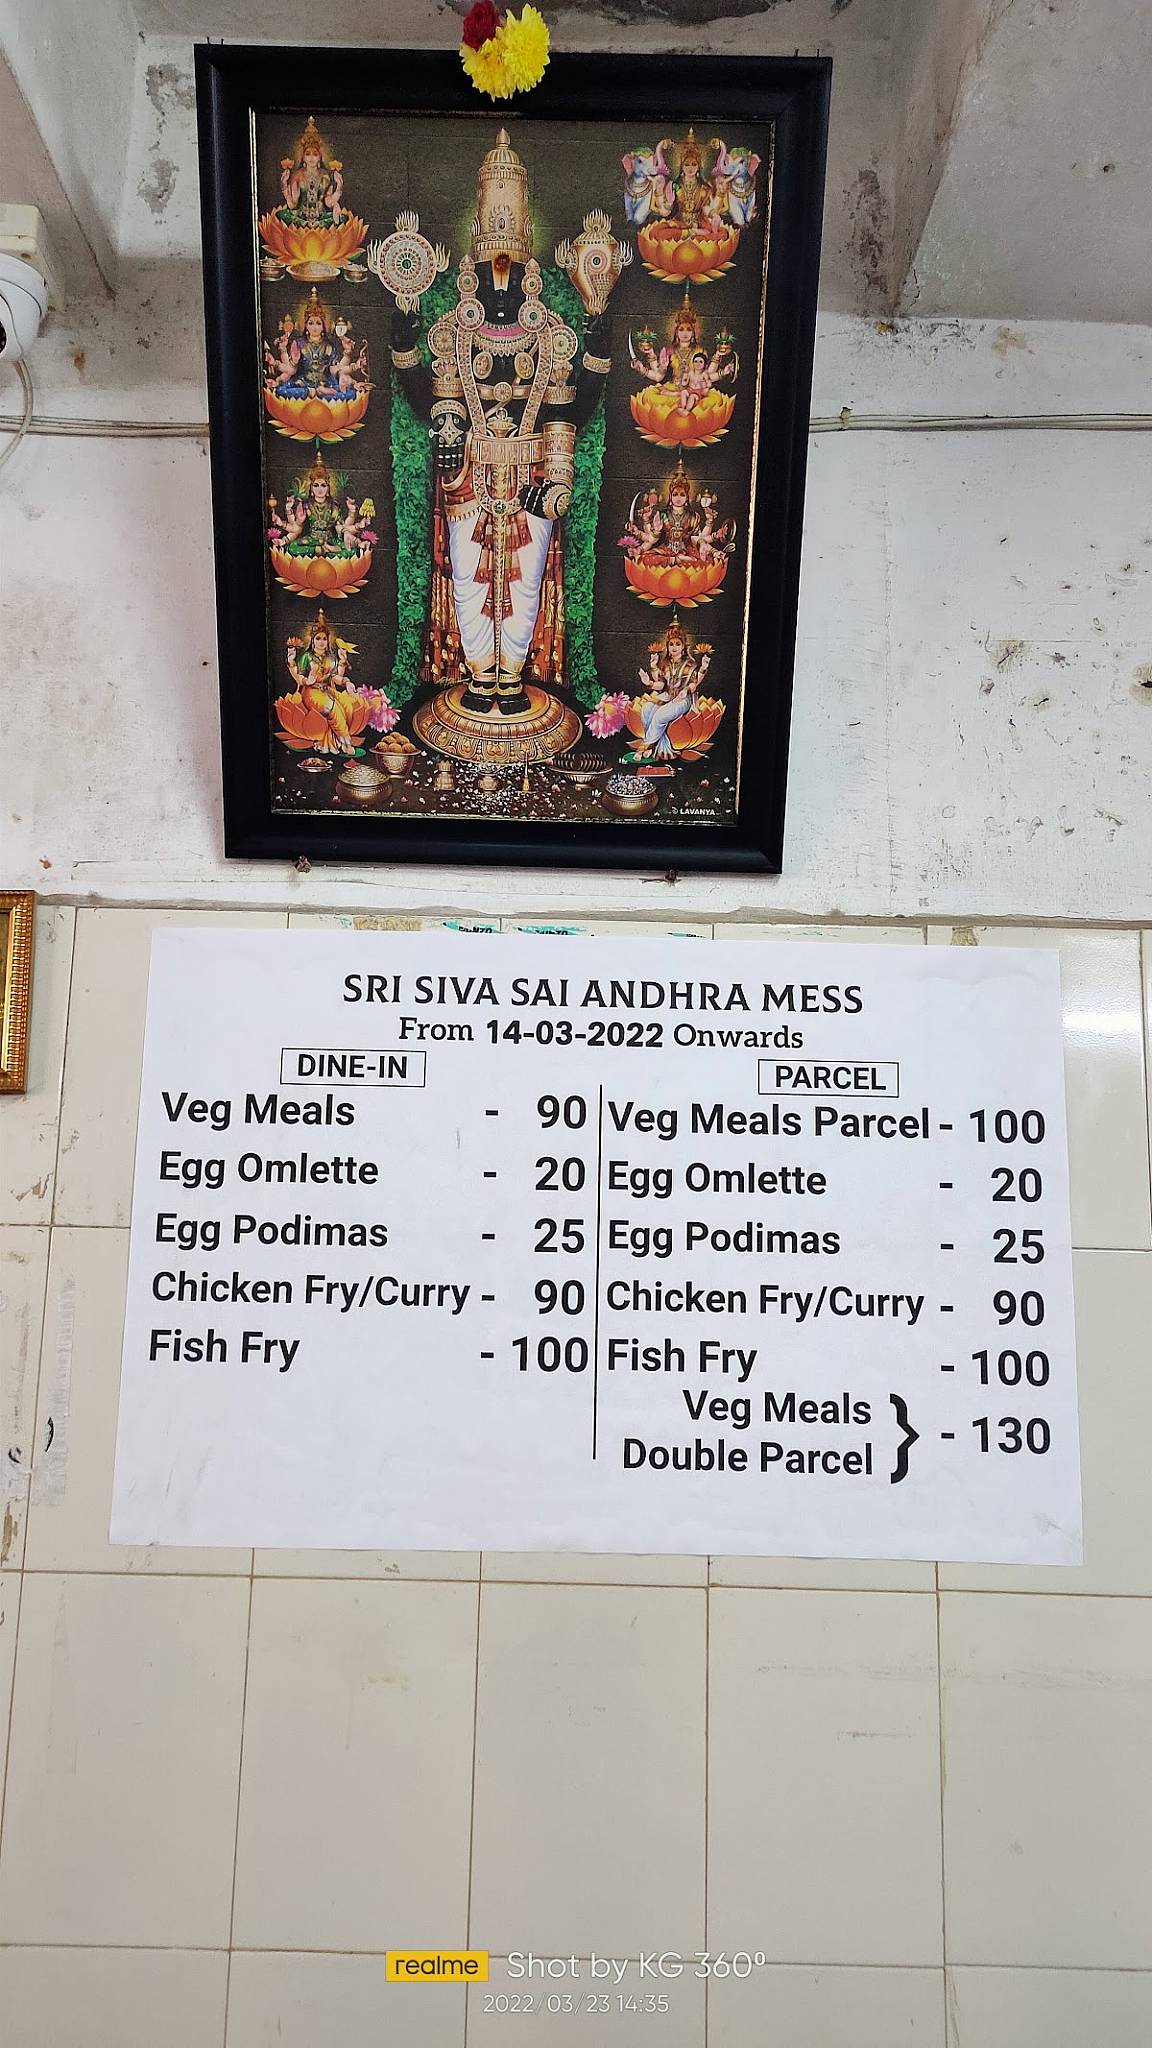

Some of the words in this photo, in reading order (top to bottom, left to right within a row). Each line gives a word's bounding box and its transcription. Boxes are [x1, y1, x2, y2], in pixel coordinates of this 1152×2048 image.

[680, 808, 716, 816] LAVANYA
[343, 974, 402, 1003] SRI
[414, 975, 500, 1006] SIVA
[511, 977, 569, 1007] SAI
[579, 979, 751, 1011] ANDHRA
[761, 983, 863, 1014] MESS
[398, 1016, 475, 1042] From
[486, 1019, 664, 1048] 14-03-2022
[673, 1023, 804, 1049] Onwards
[297, 1053, 408, 1079] DINE-IN
[775, 1065, 887, 1091] PARCEL
[161, 1091, 232, 1132] Veg
[244, 1093, 355, 1126] Meals
[537, 1094, 587, 1130] 90
[607, 1100, 678, 1141] Veg
[691, 1103, 802, 1136] Meals
[814, 1106, 929, 1139] Parcel
[969, 1108, 1046, 1145] 100
[159, 1150, 226, 1190] Egg
[237, 1152, 379, 1185] Omlette
[535, 1156, 586, 1192] 20
[608, 1160, 673, 1200] Egg
[685, 1162, 827, 1196] Omlette
[990, 1167, 1042, 1203] 20
[155, 1212, 221, 1252] Egg
[233, 1213, 388, 1247] Podimas
[534, 1217, 585, 1254] 25
[608, 1219, 673, 1259] Egg
[686, 1221, 841, 1255] Podimas
[992, 1228, 1045, 1265] 25
[152, 1270, 293, 1304] Chicken
[305, 1274, 471, 1316] Fry/Curry
[534, 1279, 585, 1316] 90
[606, 1279, 747, 1314] Chicken
[759, 1284, 925, 1326] Fry/Curry
[992, 1289, 1045, 1327] 90
[149, 1328, 227, 1363] Fish
[241, 1331, 301, 1373] Fry
[512, 1335, 589, 1373] 100
[608, 1337, 685, 1372] Fish
[699, 1340, 758, 1383] Fry
[971, 1349, 1050, 1387] 100
[682, 1389, 751, 1430] Veg
[764, 1391, 872, 1425] Meals
[623, 1437, 748, 1472] Double
[760, 1441, 873, 1475] Parcel
[972, 1416, 1051, 1455] 130
